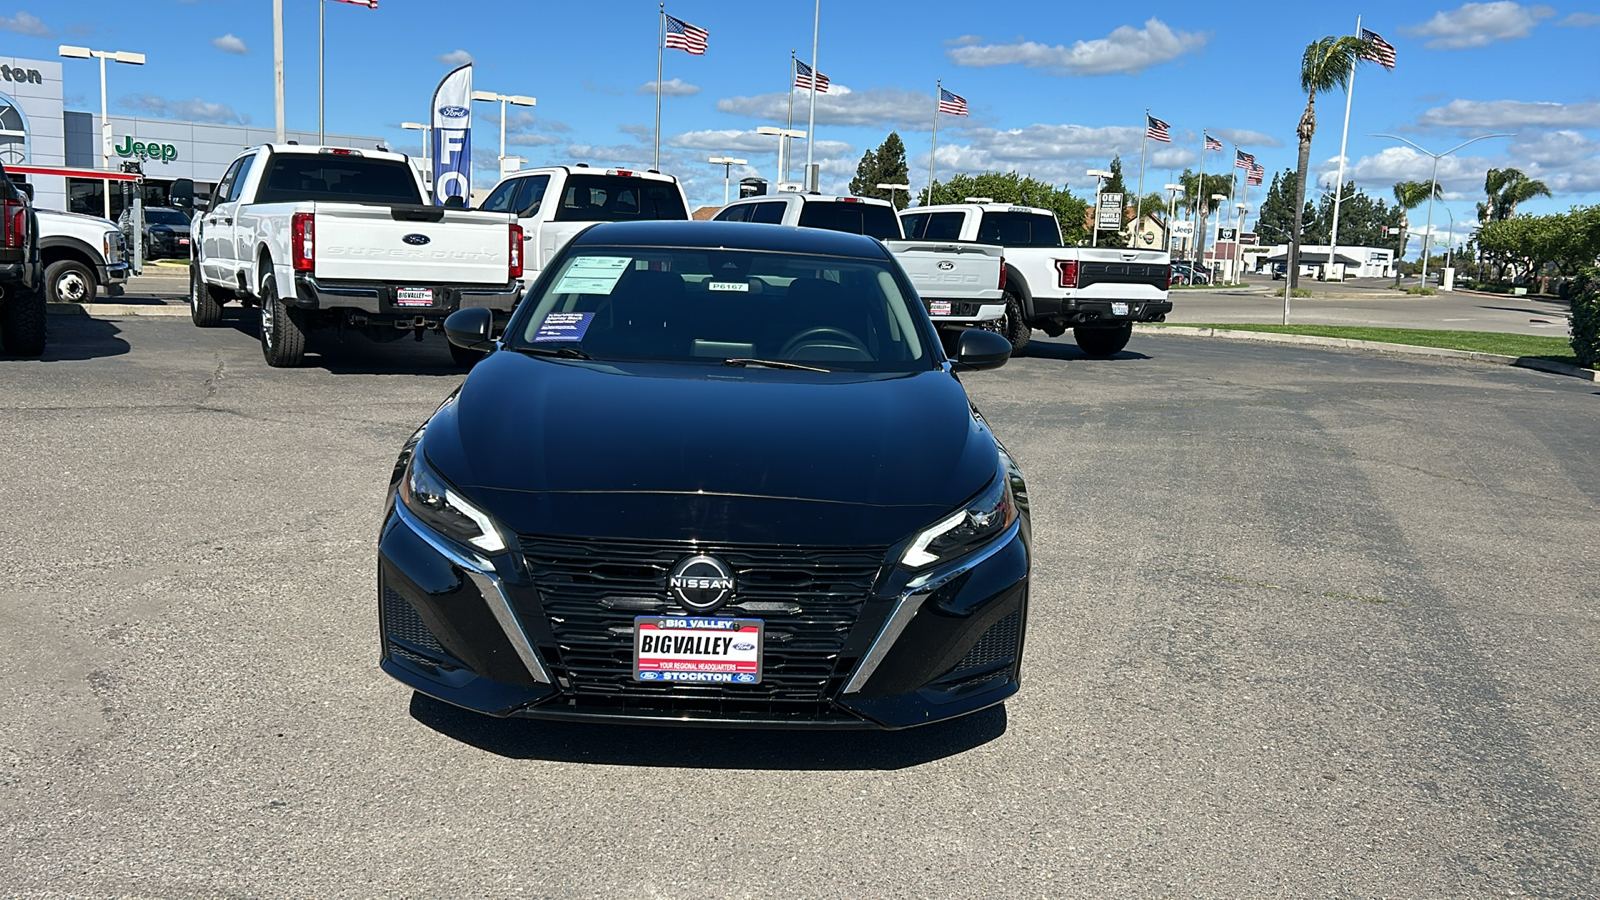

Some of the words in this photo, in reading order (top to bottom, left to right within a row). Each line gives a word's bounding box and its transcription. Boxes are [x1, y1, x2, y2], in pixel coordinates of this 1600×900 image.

[0, 63, 42, 84] ton
[443, 106, 465, 118] Ford
[115, 136, 177, 164] Jeep
[1102, 194, 1121, 202] OEM
[1174, 226, 1193, 234] Jeep
[327, 246, 424, 258] SUPER
[431, 250, 500, 261] DUTY
[908, 272, 982, 285] F-150
[670, 577, 733, 589] NISSAN
[665, 619, 688, 628] BIG
[689, 619, 733, 629] VALLEY
[641, 635, 733, 656] BIGVALLEY
[674, 662, 698, 670] REGIONAL
[698, 663, 736, 671] HEADQUARTERS
[663, 672, 732, 682] STOCKTON
